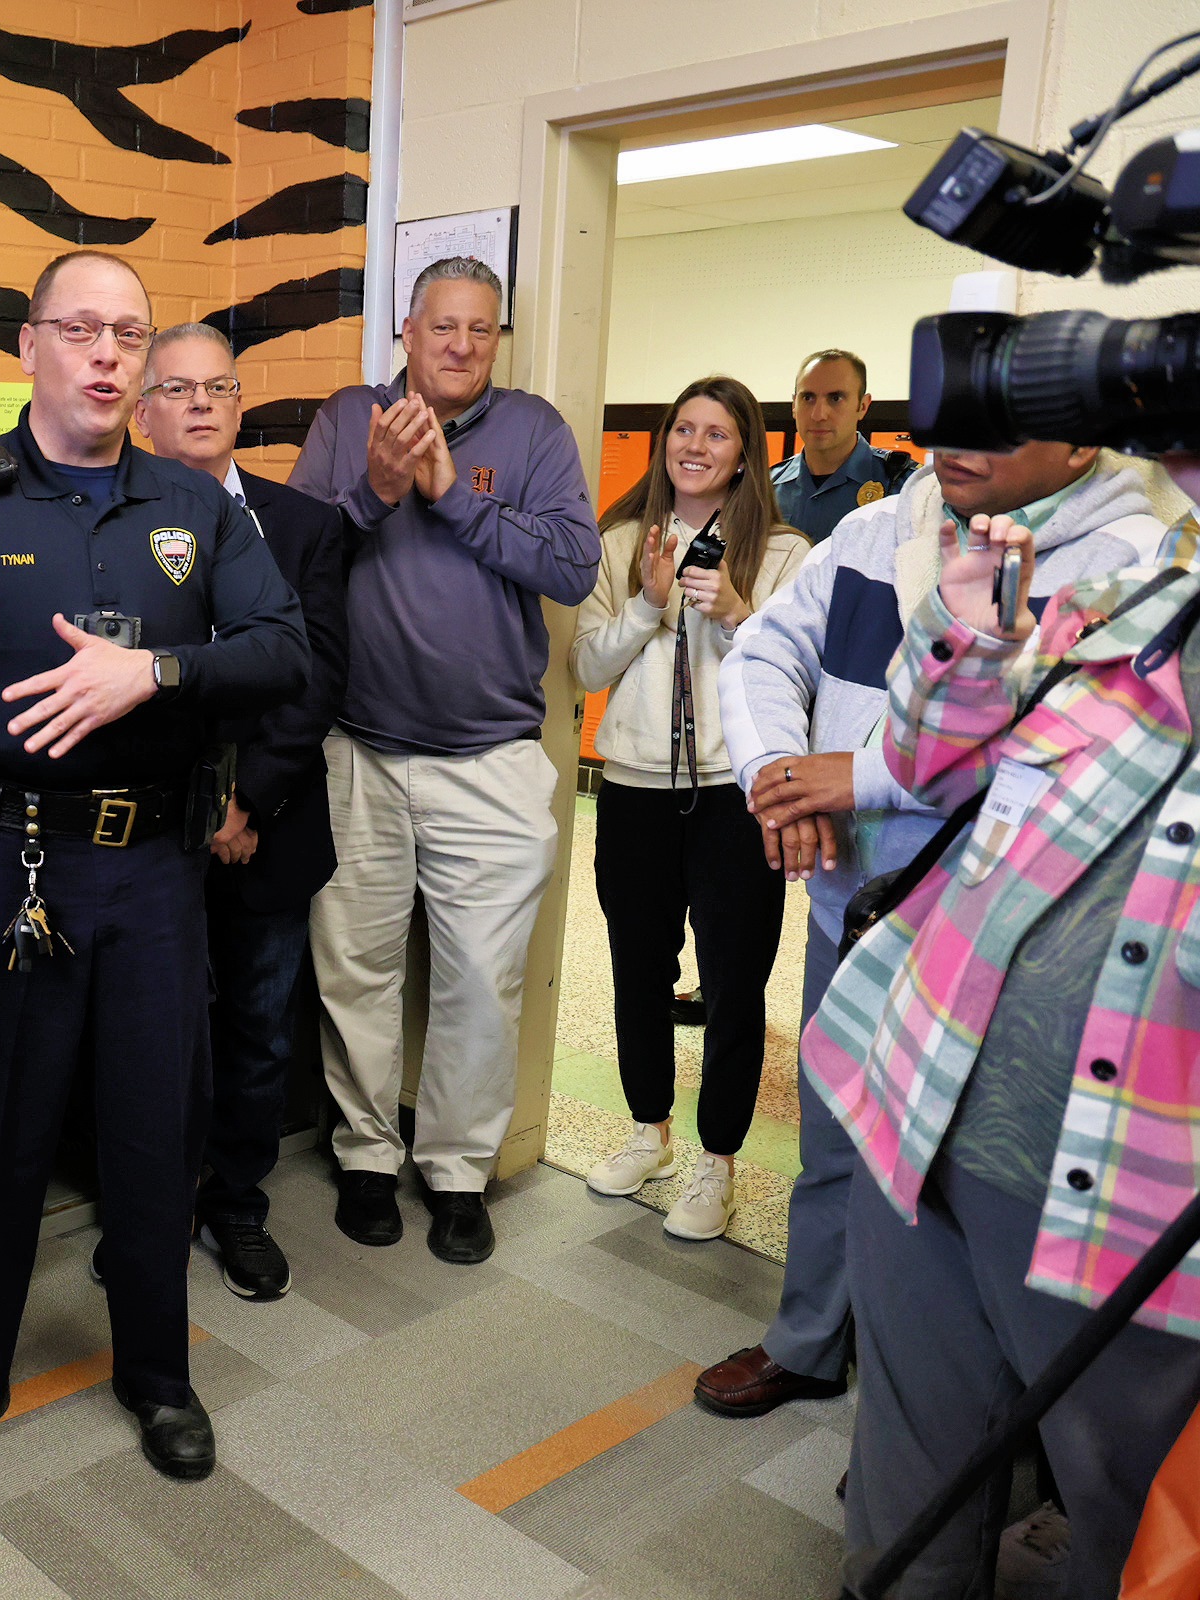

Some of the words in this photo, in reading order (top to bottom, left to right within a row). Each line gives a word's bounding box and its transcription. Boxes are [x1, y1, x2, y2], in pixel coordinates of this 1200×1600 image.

[470, 466, 497, 494] H
[153, 531, 192, 544] POLICE
[0, 553, 35, 566] TYNAN
